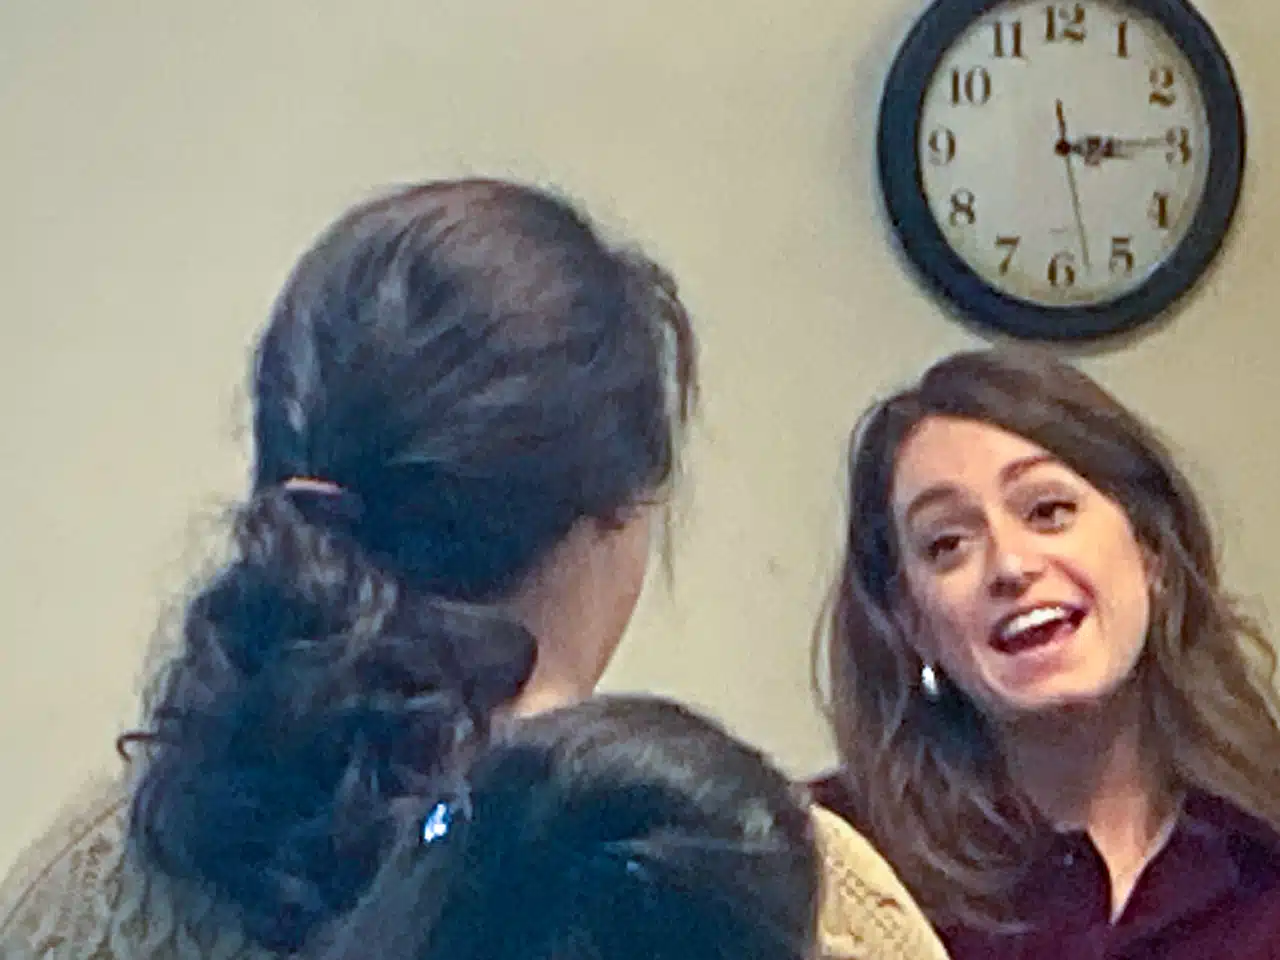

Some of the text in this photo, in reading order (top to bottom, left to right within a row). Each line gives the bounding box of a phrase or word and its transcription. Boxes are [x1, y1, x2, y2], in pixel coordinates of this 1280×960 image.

[993, 21, 1022, 58] 11
[1045, 2, 1085, 42] 12
[1117, 20, 1128, 58] 1
[951, 66, 991, 106] 10
[1149, 67, 1175, 107] 2
[928, 127, 956, 165] 9
[1165, 126, 1191, 165] 3
[949, 188, 976, 226] 8
[1147, 191, 1170, 229] 4
[995, 236, 1021, 276] 7
[1047, 251, 1076, 287] 6
[1109, 236, 1134, 273] 5
